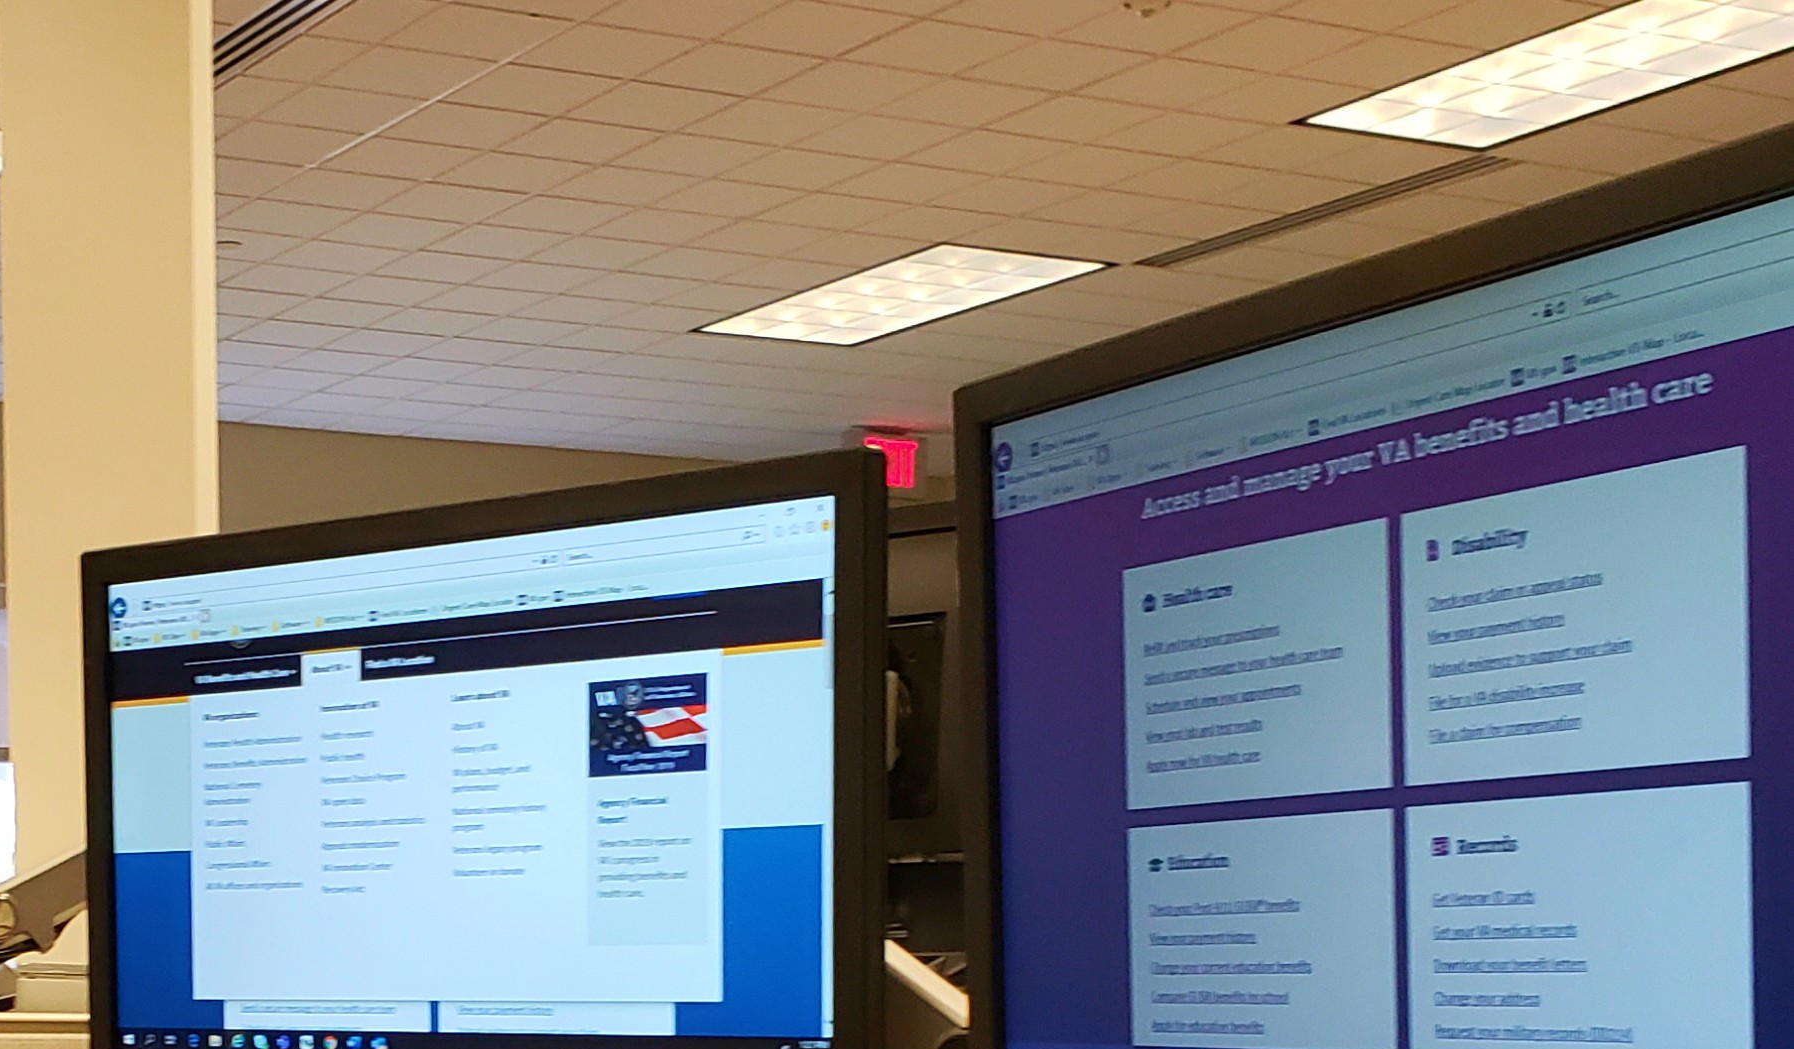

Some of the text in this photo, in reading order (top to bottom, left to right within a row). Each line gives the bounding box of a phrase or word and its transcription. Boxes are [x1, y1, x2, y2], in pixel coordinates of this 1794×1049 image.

[1140, 371, 1715, 520] Access and manage your VA benefits and health care
[1451, 528, 1529, 555] Disability
